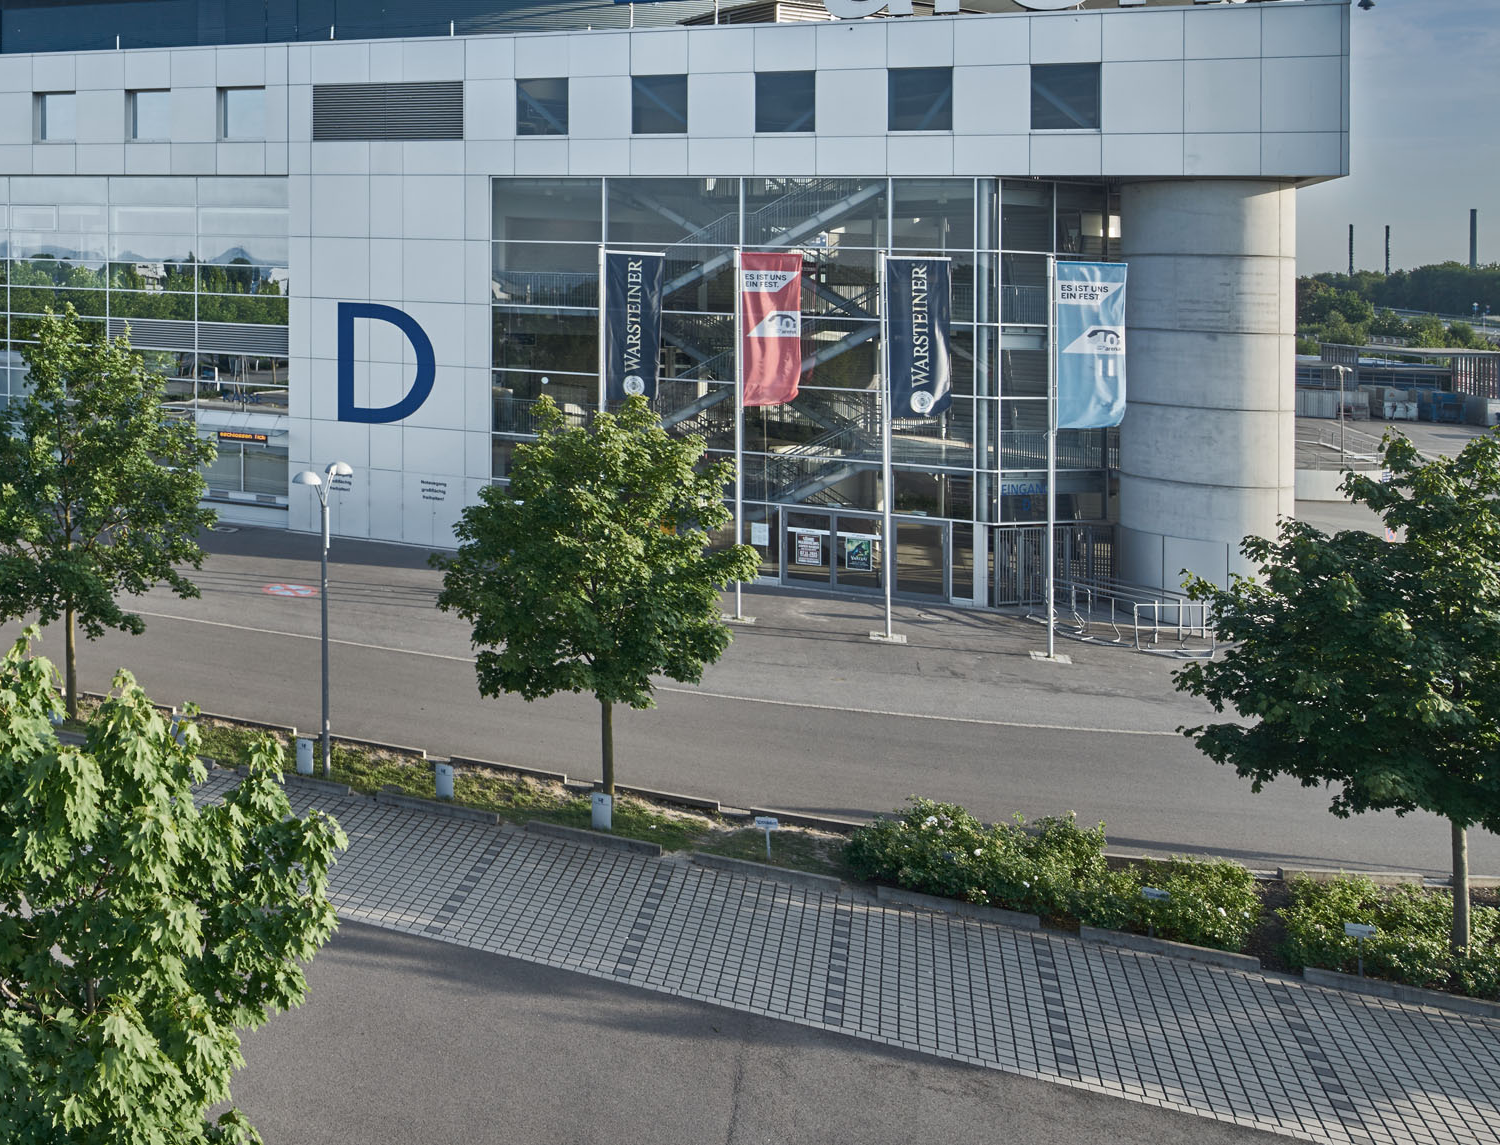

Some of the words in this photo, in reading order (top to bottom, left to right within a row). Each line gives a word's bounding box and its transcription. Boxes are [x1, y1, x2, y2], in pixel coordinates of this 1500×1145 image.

[337, 301, 436, 423] D
[623, 259, 643, 373] WARSTEINER
[911, 264, 930, 388] WARSTEINER
[222, 391, 262, 404] KASSE
[1001, 483, 1048, 496] EINGAN
